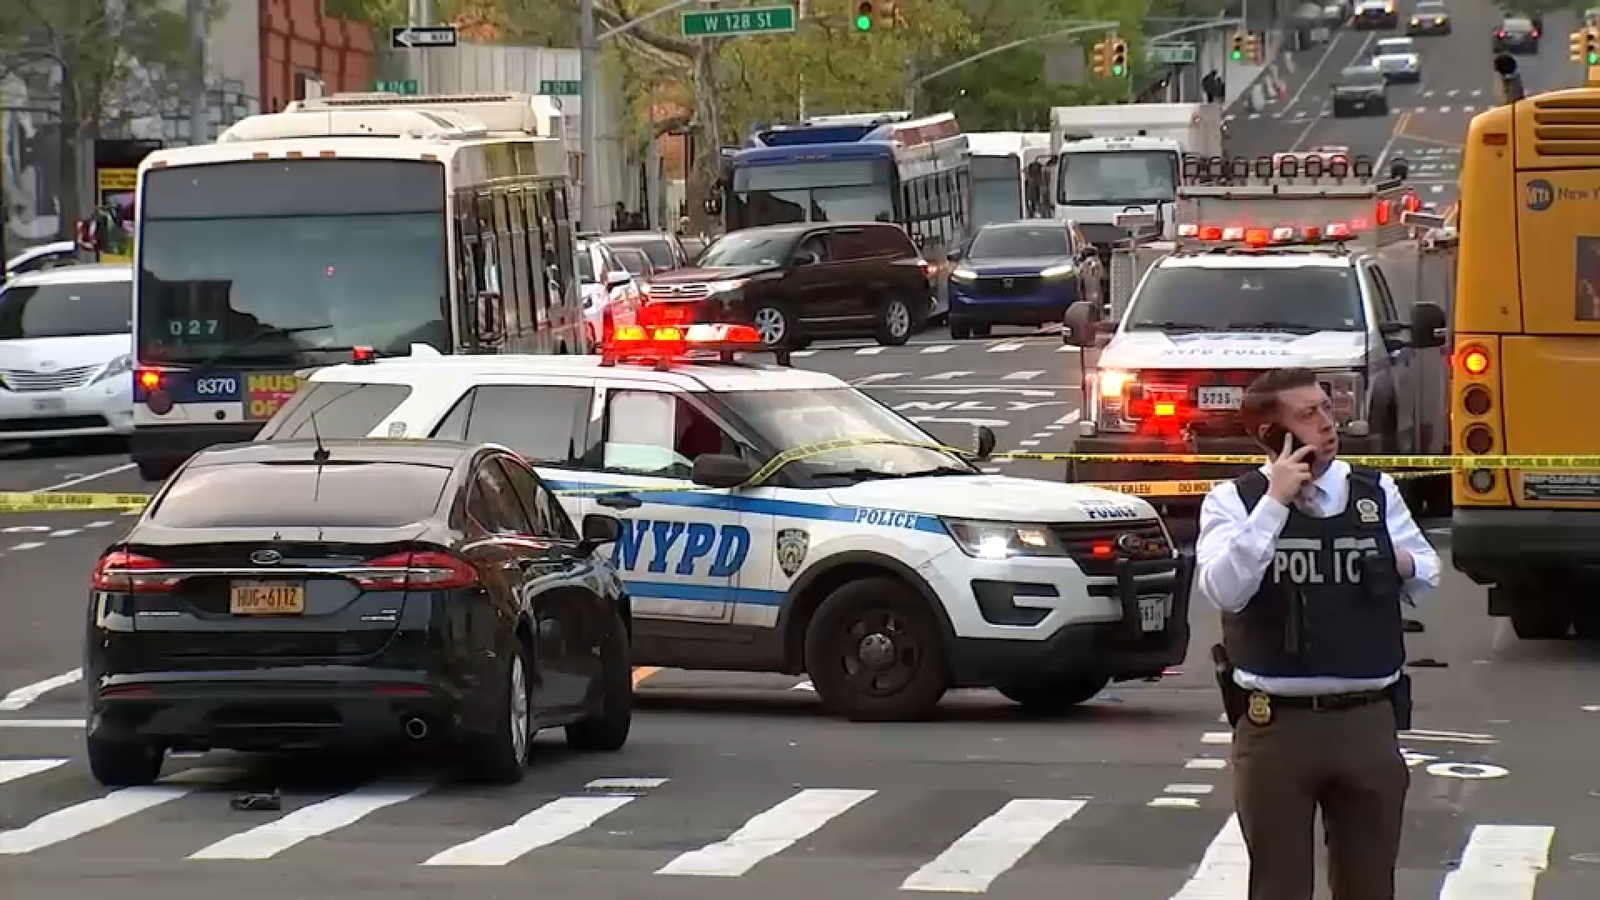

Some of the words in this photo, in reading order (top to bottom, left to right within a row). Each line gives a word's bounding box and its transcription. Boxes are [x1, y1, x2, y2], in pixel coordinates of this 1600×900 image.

[704, 15, 719, 31] W
[726, 14, 751, 30] 128
[758, 12, 773, 28] St
[1558, 187, 1588, 200] New
[197, 378, 236, 394] 8370
[248, 374, 300, 392] MUS
[892, 401, 1068, 411] NLY
[856, 508, 917, 530] POLICE
[611, 518, 750, 577] NYPD
[1274, 550, 1379, 584] POLIC
